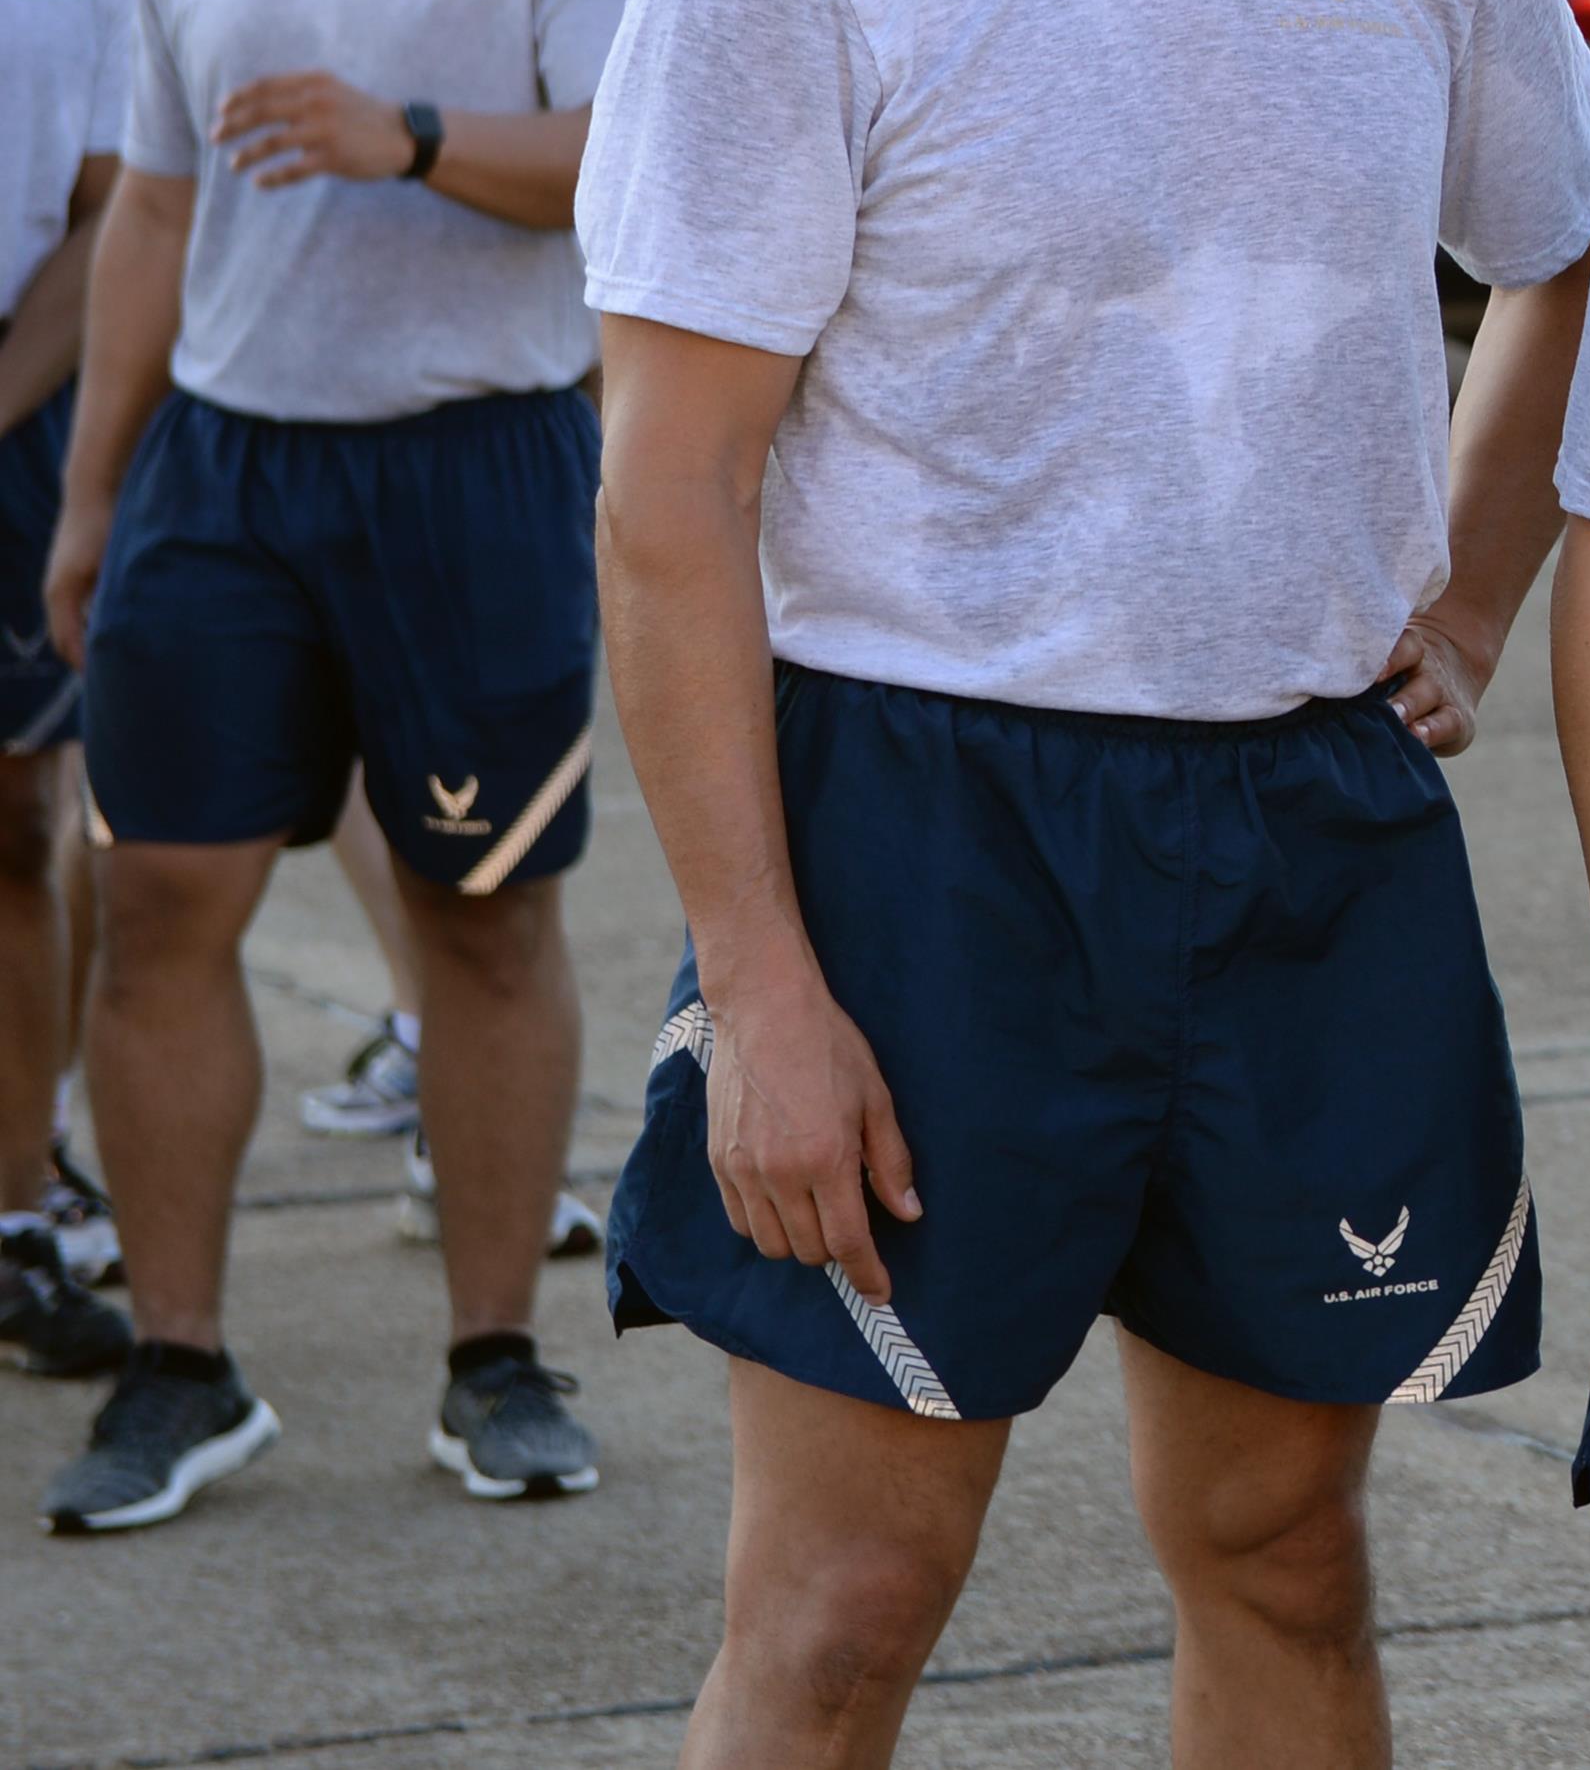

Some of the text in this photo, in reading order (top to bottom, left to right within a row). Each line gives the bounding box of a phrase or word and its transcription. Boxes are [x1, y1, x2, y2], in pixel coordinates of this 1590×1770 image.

[1323, 1278, 1439, 1304] U.S. AIR FORCE
